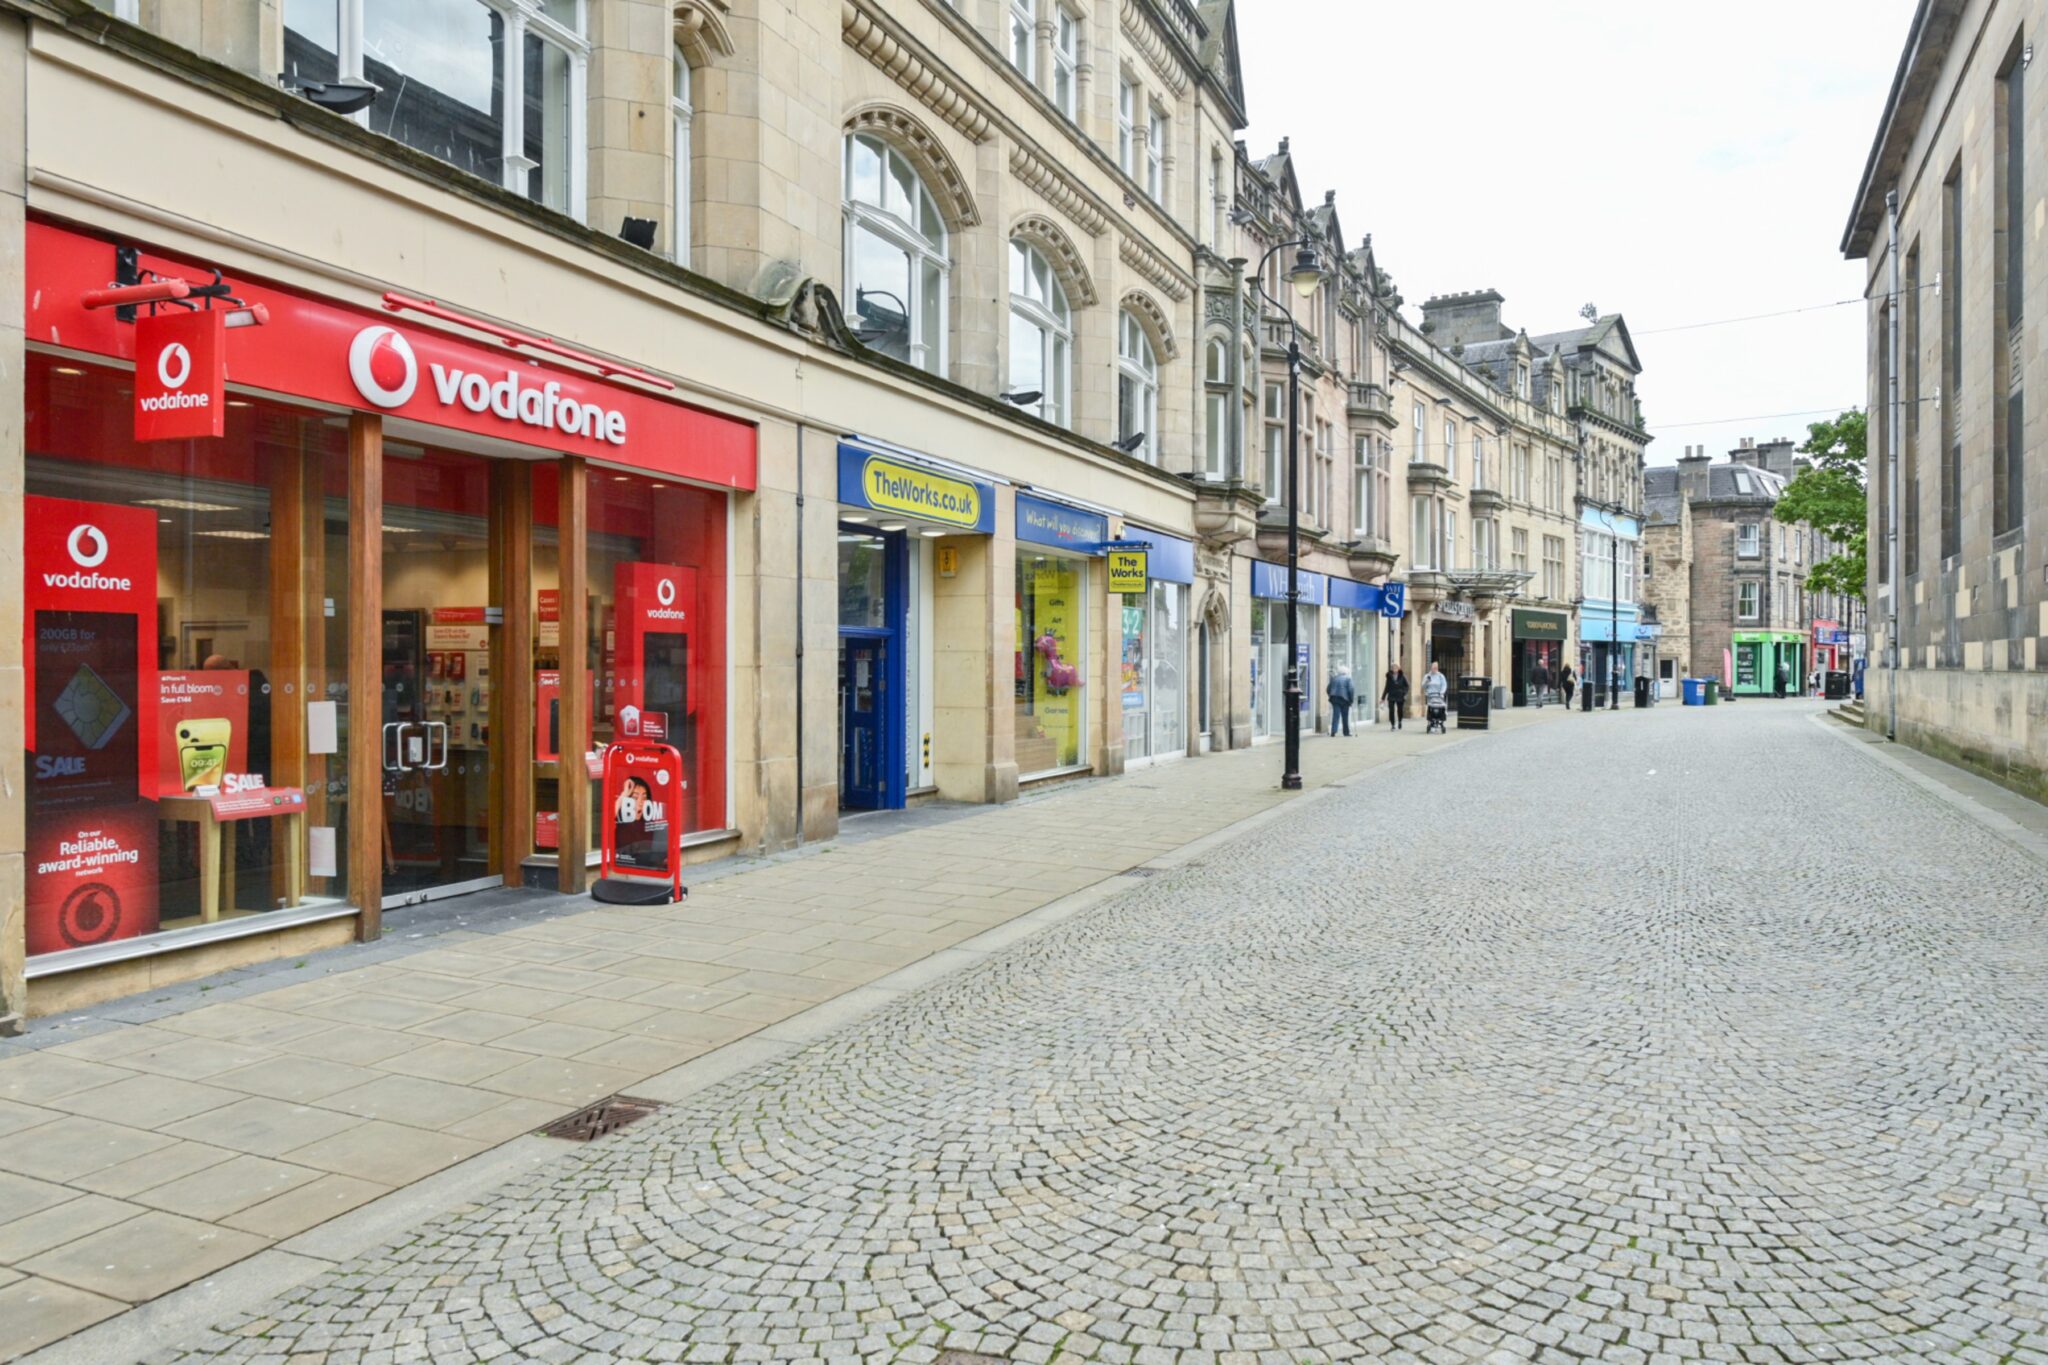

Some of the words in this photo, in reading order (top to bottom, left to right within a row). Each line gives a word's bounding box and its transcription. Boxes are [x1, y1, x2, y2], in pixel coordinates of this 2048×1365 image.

[140, 390, 209, 412] vodafone
[429, 363, 626, 445] vodafone
[873, 471, 973, 515] TheWorks.co.uk
[1118, 556, 1137, 567] The
[43, 572, 131, 591] vodafone
[1111, 568, 1144, 578] Works
[1267, 566, 1315, 601] WHmith
[647, 607, 685, 620] vodafone
[1384, 592, 1400, 616] S
[40, 628, 77, 640] 200GB
[171, 683, 185, 694] full
[187, 683, 215, 694] bloom
[36, 755, 87, 779] SALE
[224, 773, 265, 794] SALE
[78, 831, 89, 839] On
[60, 837, 119, 856] Reliable,
[38, 849, 138, 874] award-winning
